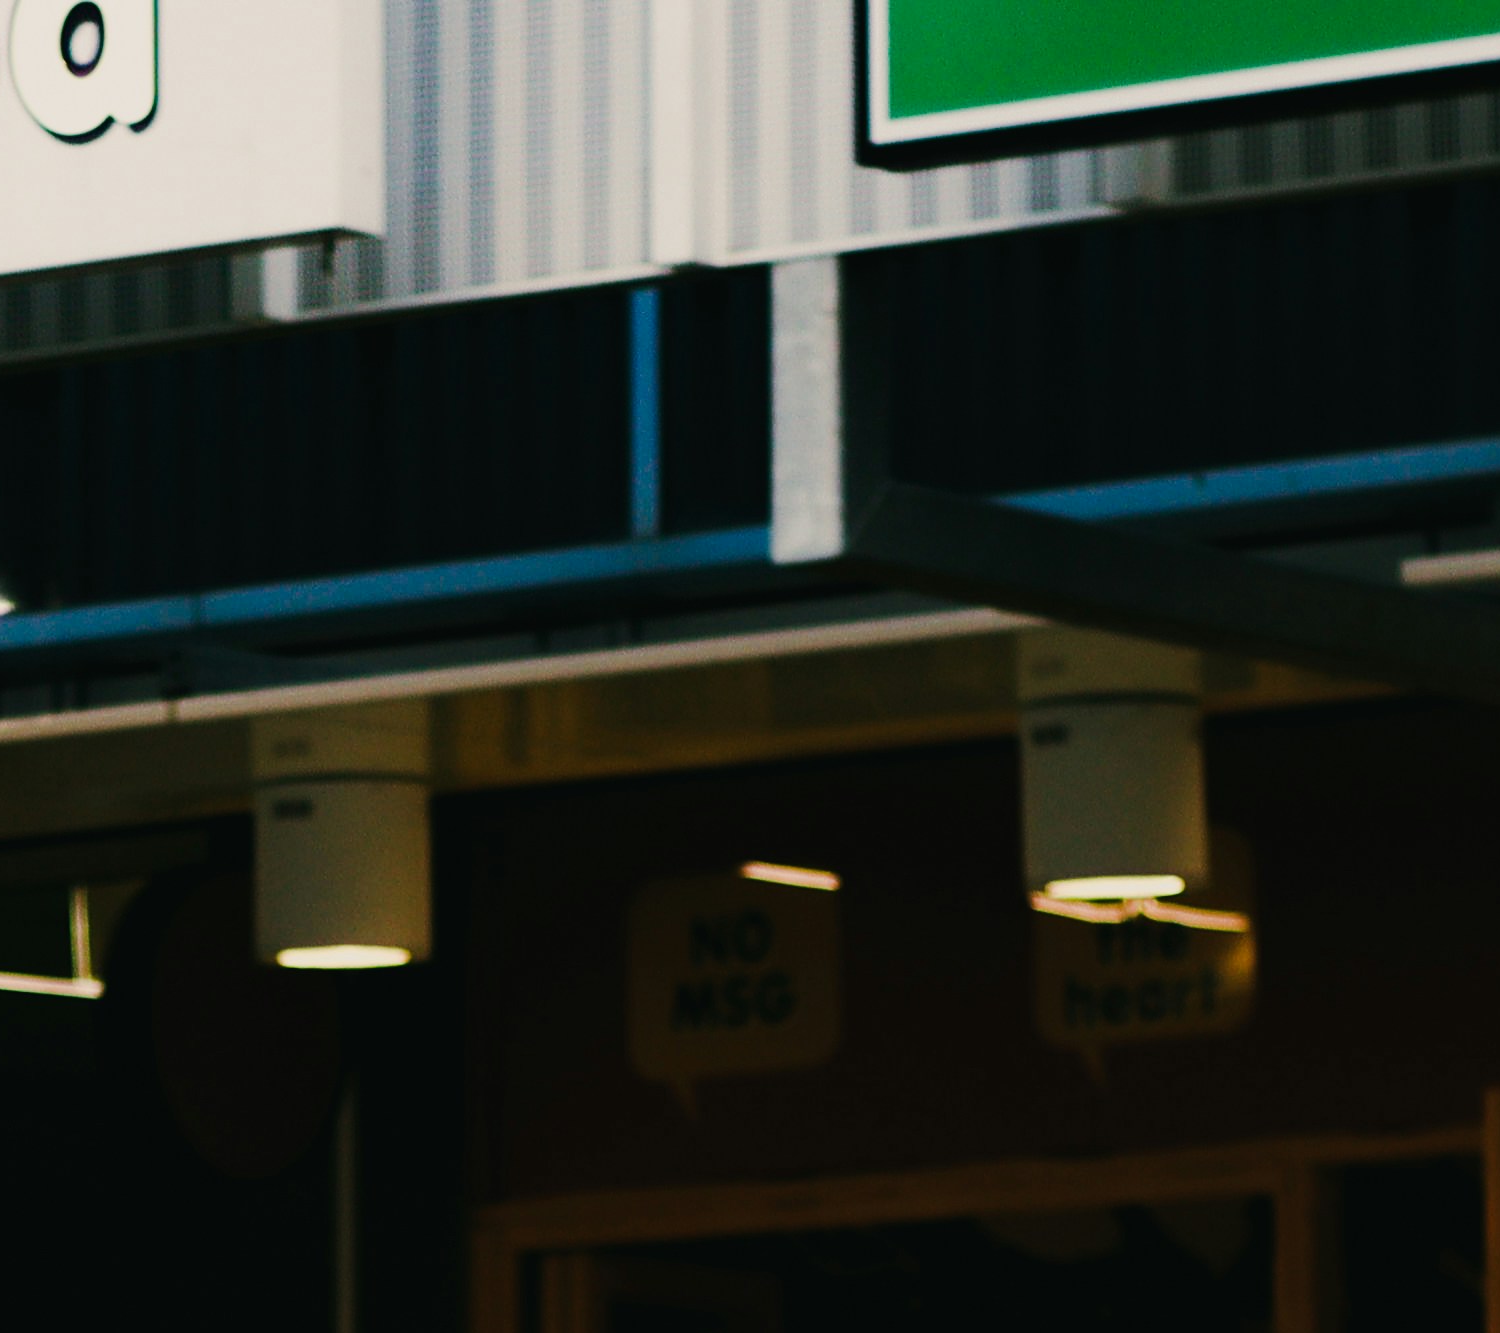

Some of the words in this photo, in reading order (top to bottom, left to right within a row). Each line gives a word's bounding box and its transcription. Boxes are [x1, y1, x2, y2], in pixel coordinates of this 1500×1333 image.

[689, 907, 776, 967] NO
[672, 970, 796, 1031] MSG
[1063, 966, 1220, 1030] heart
